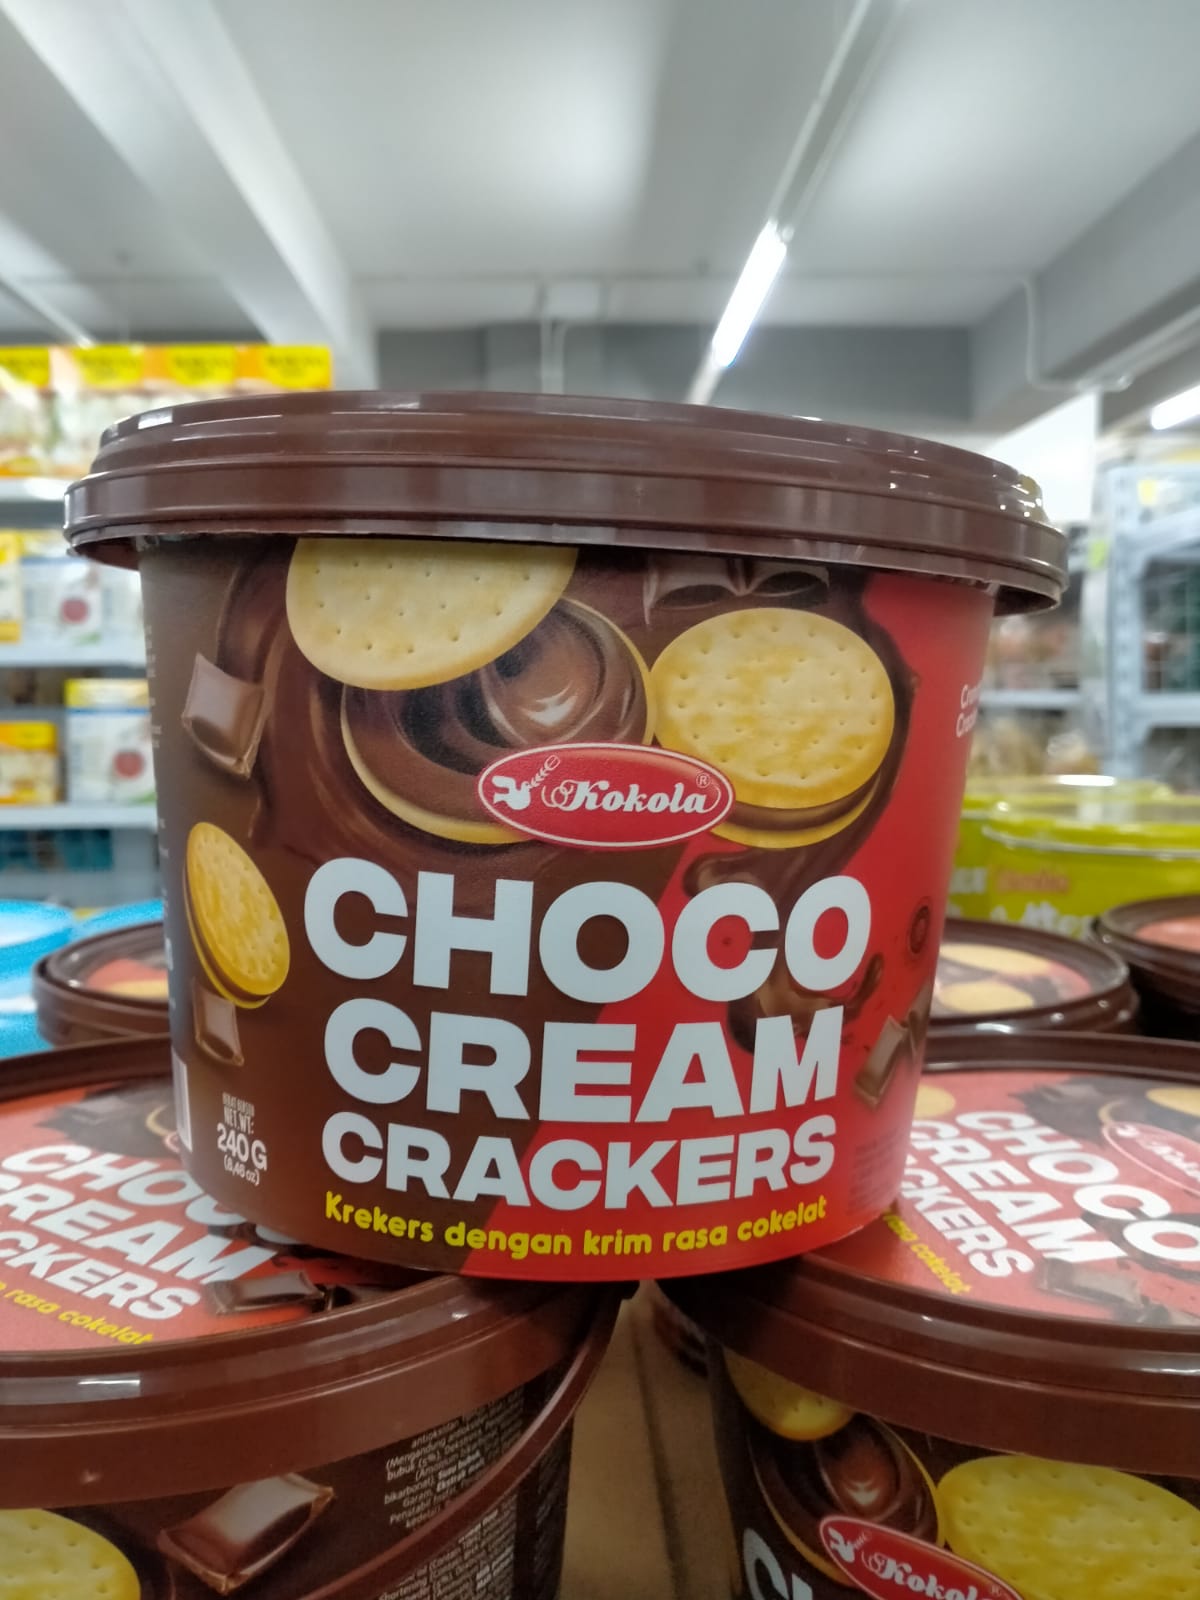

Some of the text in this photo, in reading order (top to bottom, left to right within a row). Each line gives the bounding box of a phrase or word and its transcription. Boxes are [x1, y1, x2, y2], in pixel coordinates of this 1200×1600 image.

[541, 778, 722, 814] Kokola
[303, 856, 872, 1003] CHOCO
[323, 997, 845, 1124] CREAM
[216, 1122, 268, 1172] 240 G
[321, 1111, 837, 1211] CRACKERS
[955, 1110, 1200, 1262] CHOCO
[0, 1173, 278, 1285] REAM
[325, 1191, 828, 1260] Krekers dengan krim rasa cokelat
[4, 1289, 154, 1345] rasa cokelat
[861, 1552, 986, 1600] Kokol
